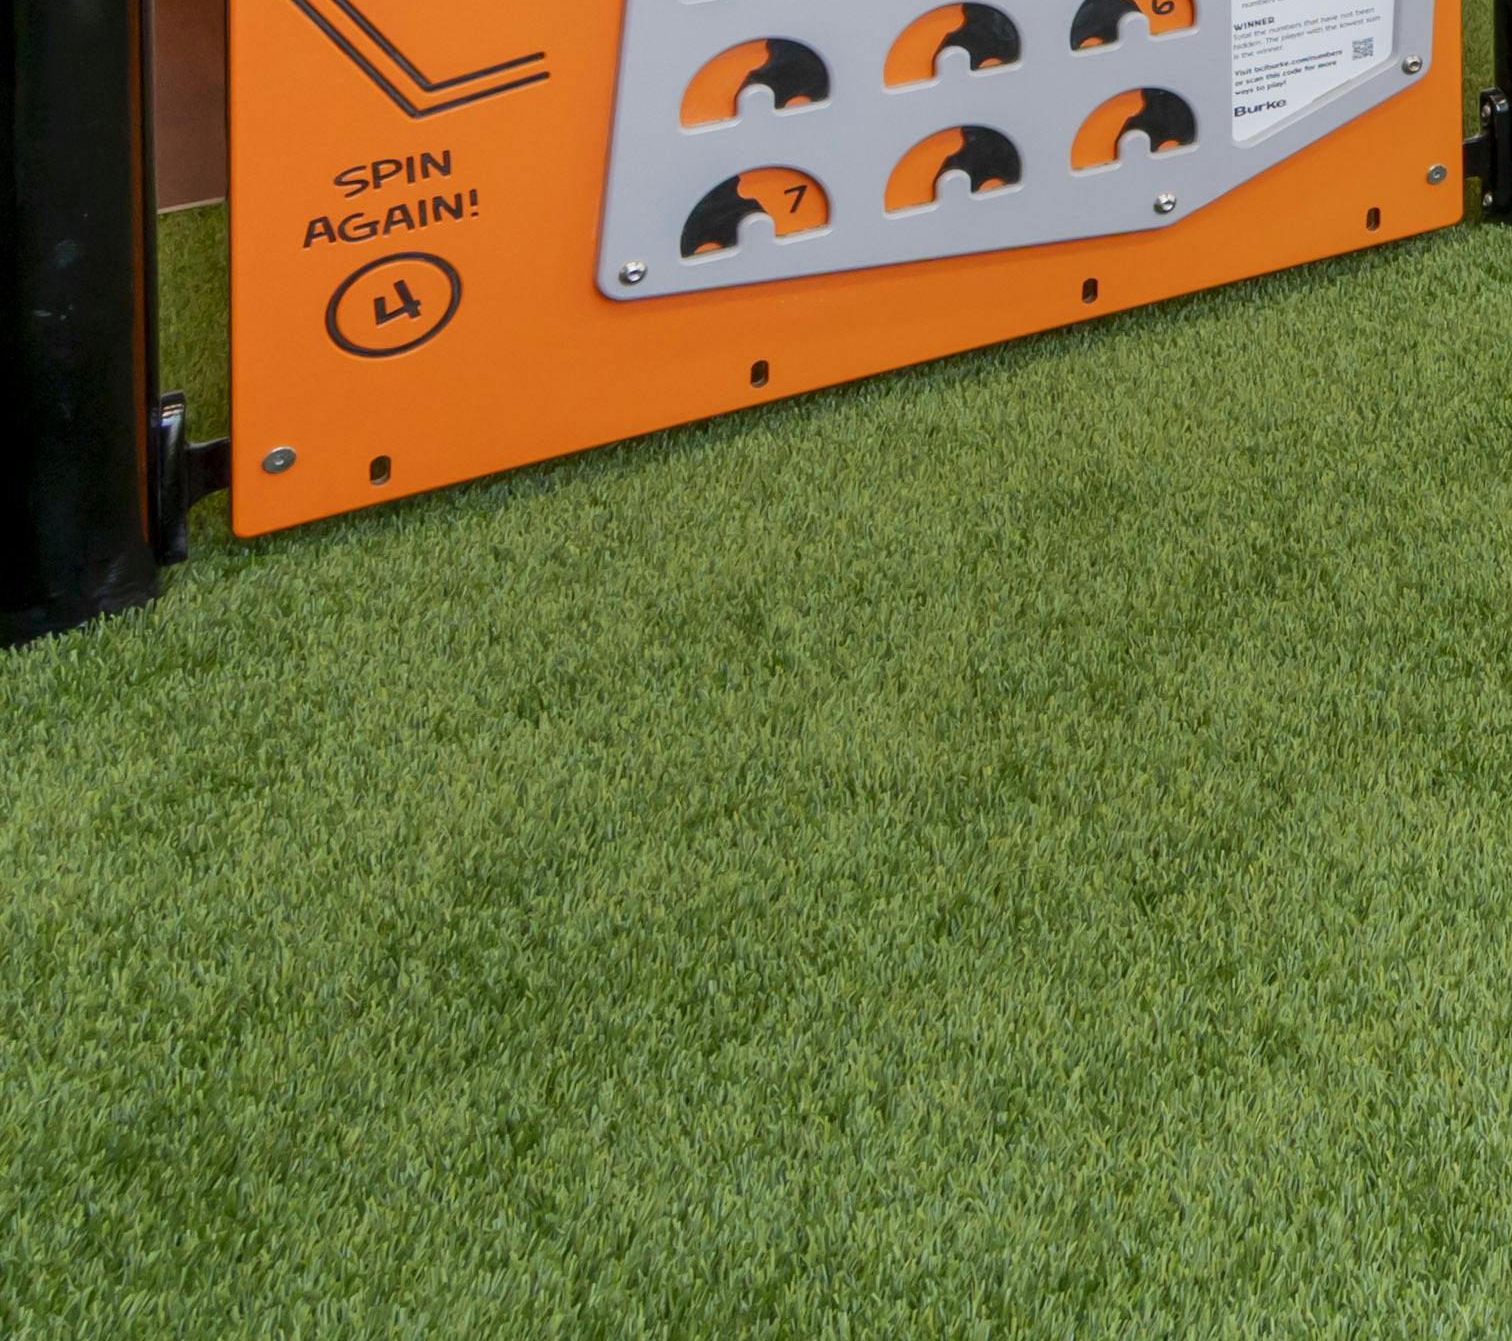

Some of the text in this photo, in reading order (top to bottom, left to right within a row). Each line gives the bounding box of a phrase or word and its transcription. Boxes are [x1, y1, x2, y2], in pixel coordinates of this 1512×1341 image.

[1234, 17, 1275, 31] WINNER
[1269, 23, 1302, 33] numbers
[1304, 18, 1320, 27] that
[1341, 11, 1353, 20] not
[1235, 67, 1252, 76] Visit
[1246, 76, 1264, 84] scan
[1266, 72, 1281, 80] this
[1283, 68, 1302, 77] code
[1318, 62, 1337, 70] more
[1235, 88, 1254, 96] ways
[1234, 100, 1287, 117] Burke
[334, 150, 450, 198] SPIN
[784, 185, 807, 213] 7
[303, 189, 478, 248] AGAIN!
[375, 281, 420, 324] 4
